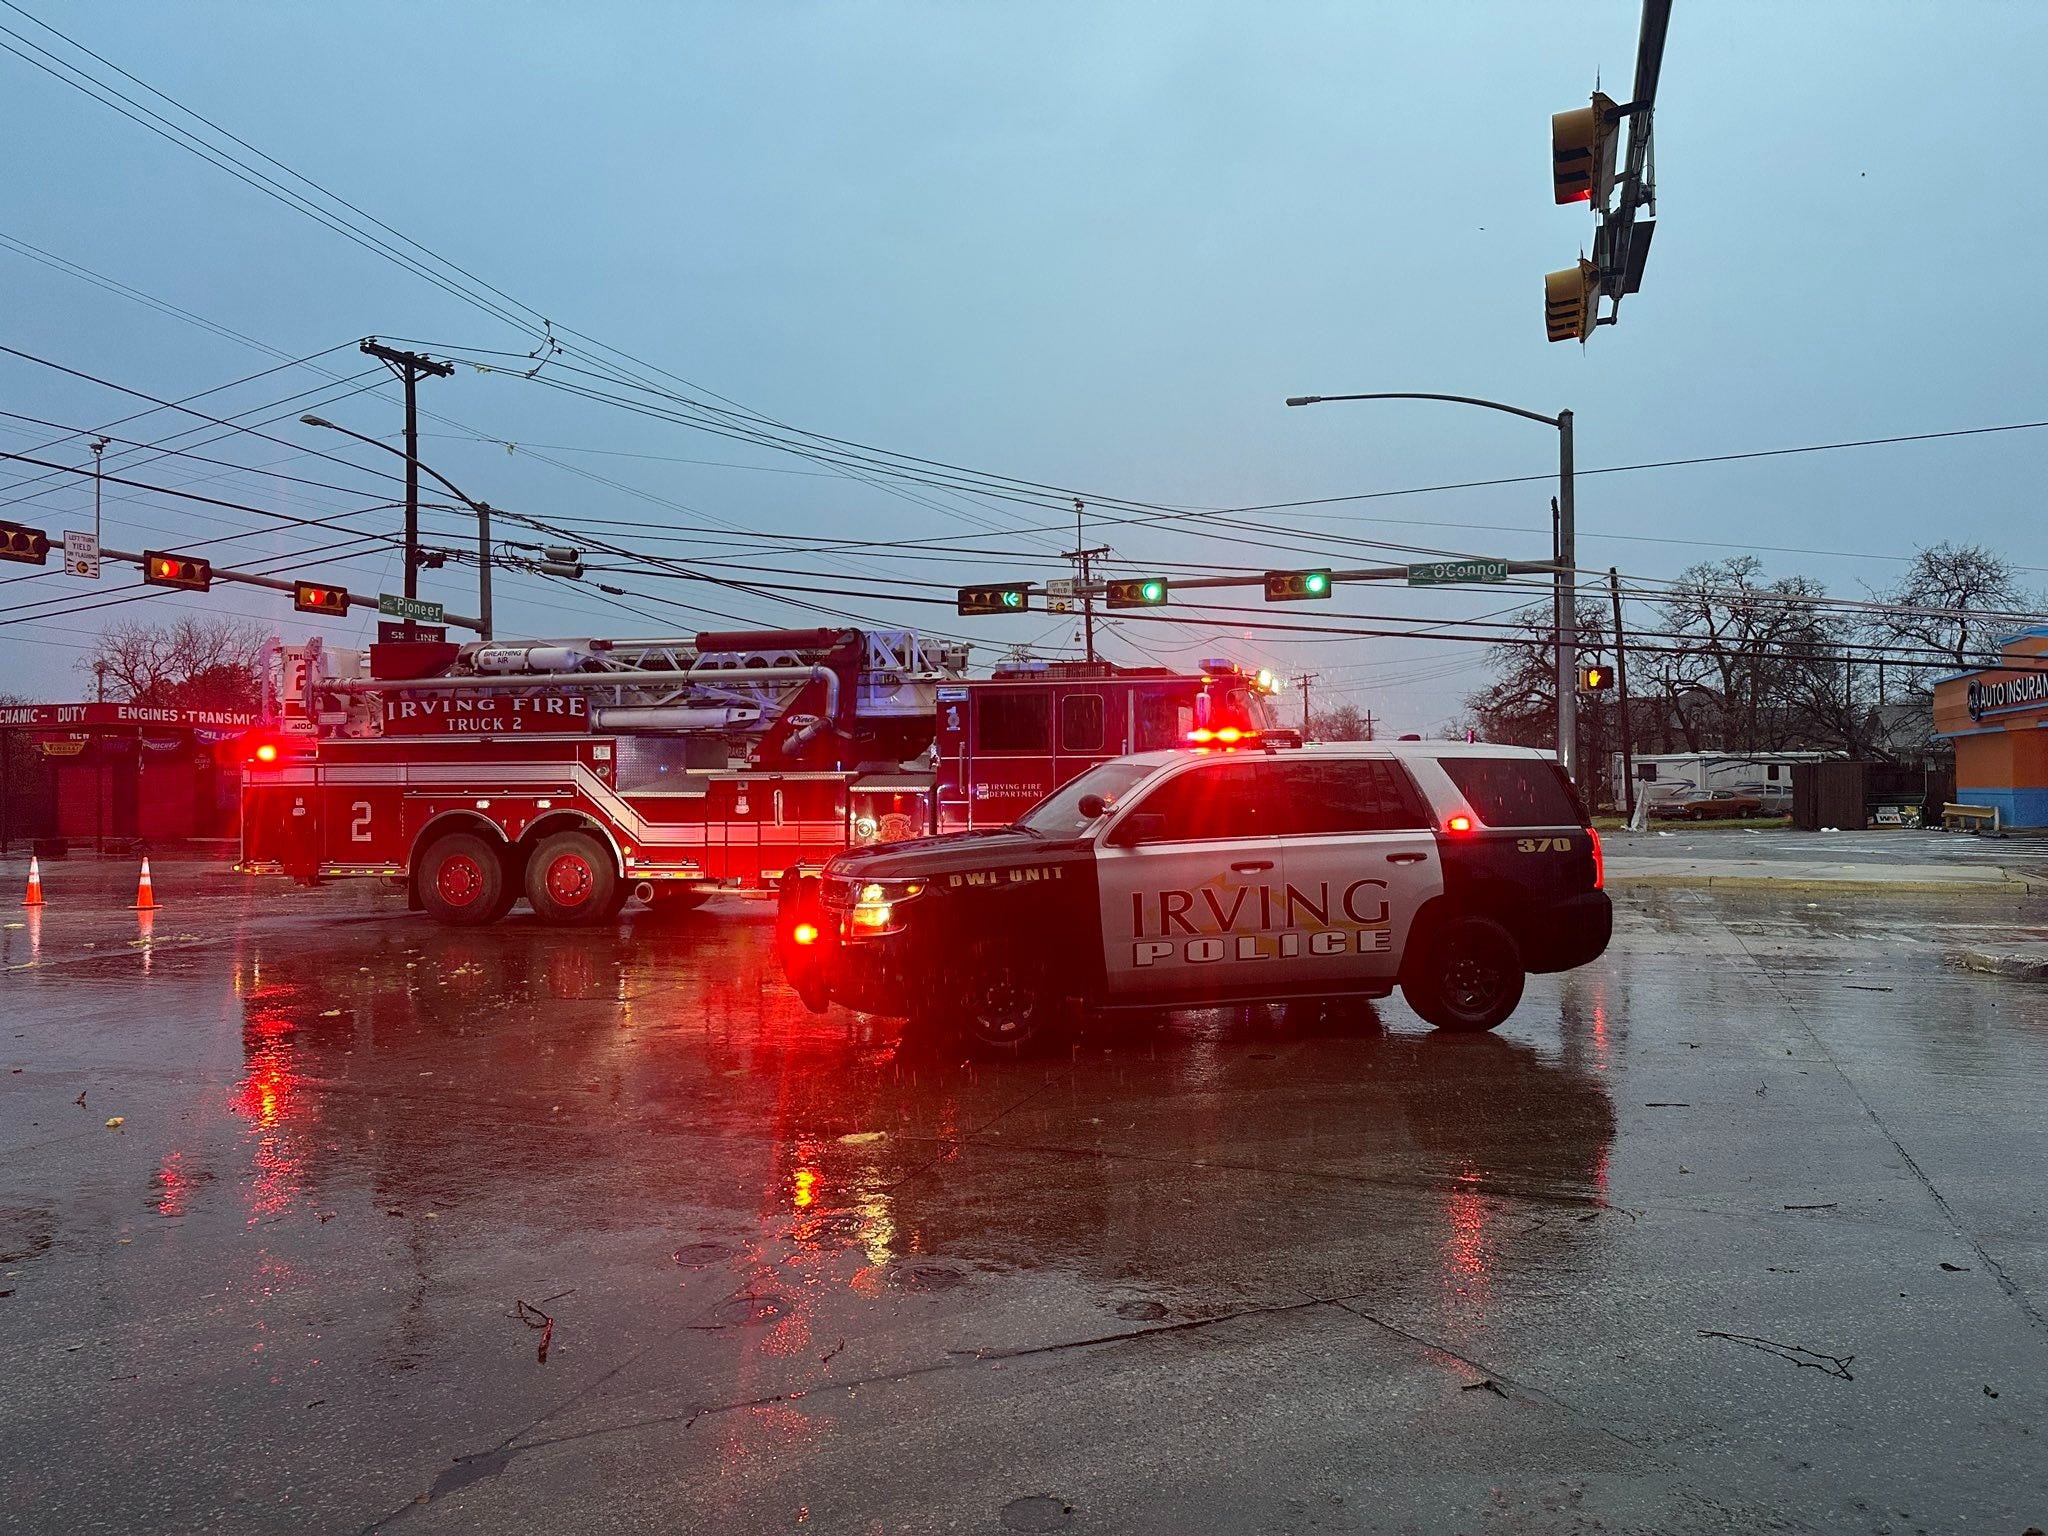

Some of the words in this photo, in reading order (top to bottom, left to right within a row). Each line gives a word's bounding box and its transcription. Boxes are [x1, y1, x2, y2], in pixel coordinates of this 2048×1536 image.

[73, 542, 91, 551] YIELD
[398, 598, 441, 616] Pioneer
[1980, 683, 2004, 708] AUTO
[58, 706, 87, 722] DUTY
[118, 706, 178, 721] ENGINES
[388, 700, 495, 721] IRVING
[513, 697, 585, 717] FIRE
[447, 717, 504, 731] TRUCK
[513, 717, 522, 730] 2
[351, 801, 372, 841] 2
[1517, 838, 1571, 853] 370
[949, 871, 997, 887] DWI
[1009, 866, 1063, 882] UNIT
[1132, 878, 1391, 939] IRVING
[1133, 928, 1391, 968] POLICE
